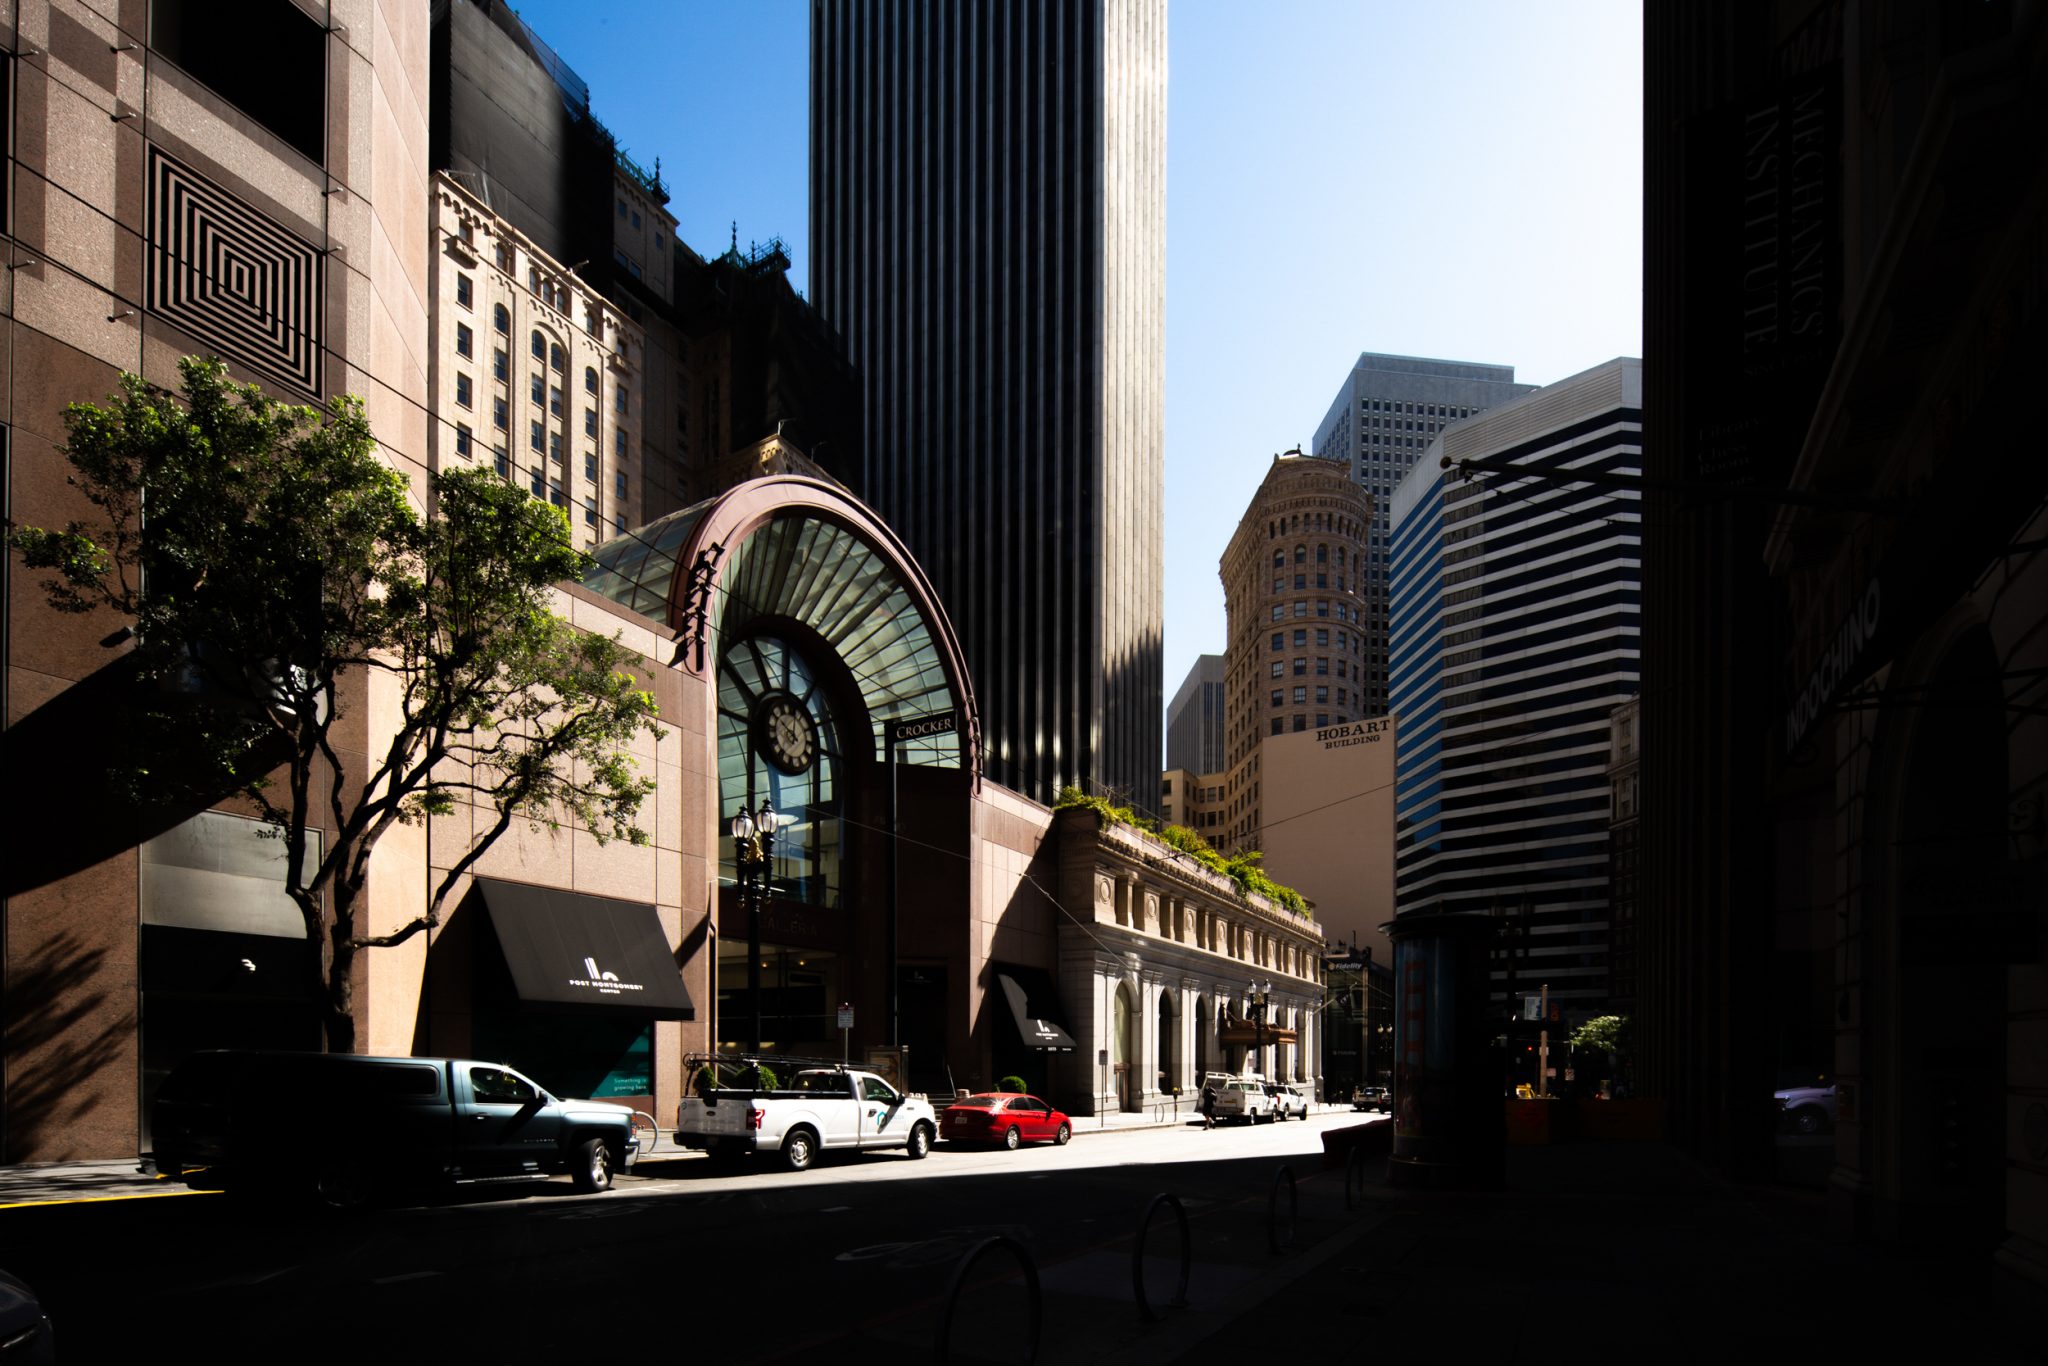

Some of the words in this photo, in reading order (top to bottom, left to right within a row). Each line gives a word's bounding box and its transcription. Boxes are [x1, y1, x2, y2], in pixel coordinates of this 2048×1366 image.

[1744, 101, 1779, 354] INSTITUTE
[1787, 576, 1880, 753] INDOCHINO
[896, 718, 952, 739] CROCKER
[1316, 719, 1390, 742] HOBART
[1325, 735, 1381, 750] BUILDING
[592, 981, 643, 990] MONTGOMERY
